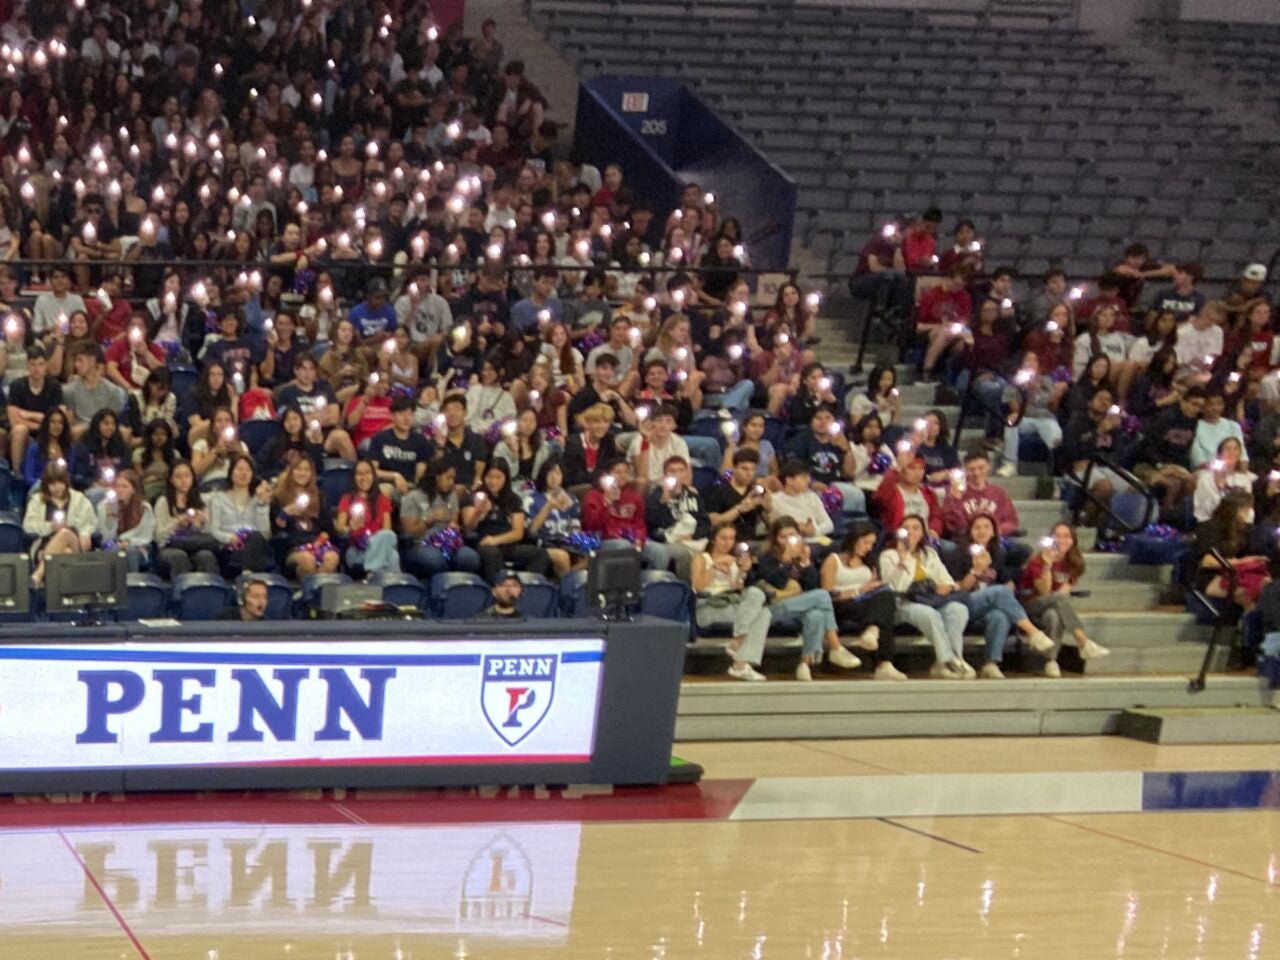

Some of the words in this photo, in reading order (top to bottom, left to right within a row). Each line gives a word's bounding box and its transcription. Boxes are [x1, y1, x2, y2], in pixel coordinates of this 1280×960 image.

[488, 658, 553, 676] PENN
[76, 667, 398, 745] PENN
[502, 687, 536, 728] P
